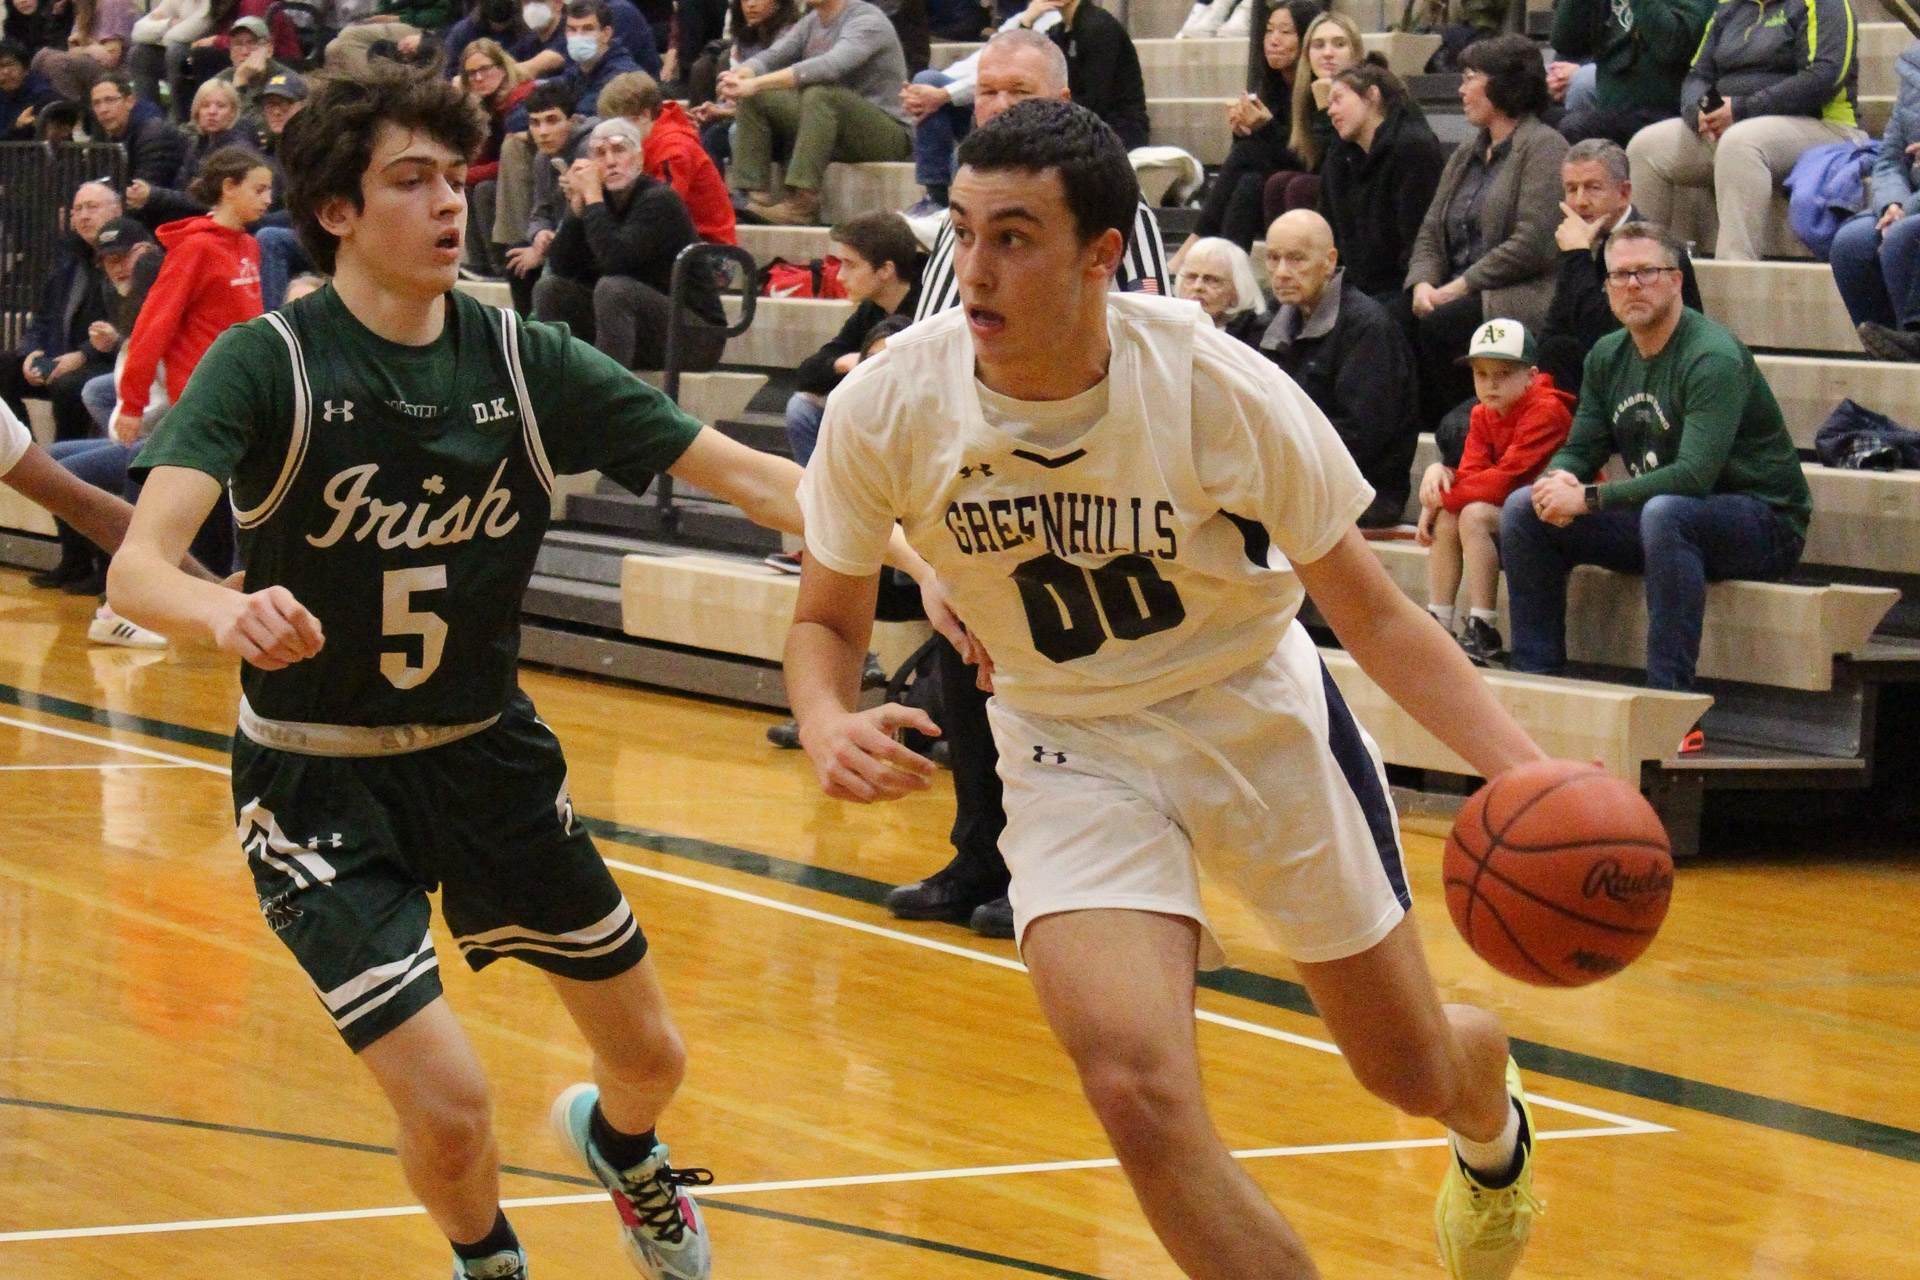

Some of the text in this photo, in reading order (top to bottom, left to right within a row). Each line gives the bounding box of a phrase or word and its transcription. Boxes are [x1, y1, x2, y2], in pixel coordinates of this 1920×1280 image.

[1478, 325, 1505, 344] A's
[472, 397, 515, 424] D.K.
[305, 457, 520, 550] Irish
[945, 491, 1178, 560] GREENHILLS
[379, 564, 449, 690] 5
[1008, 552, 1187, 664] 00
